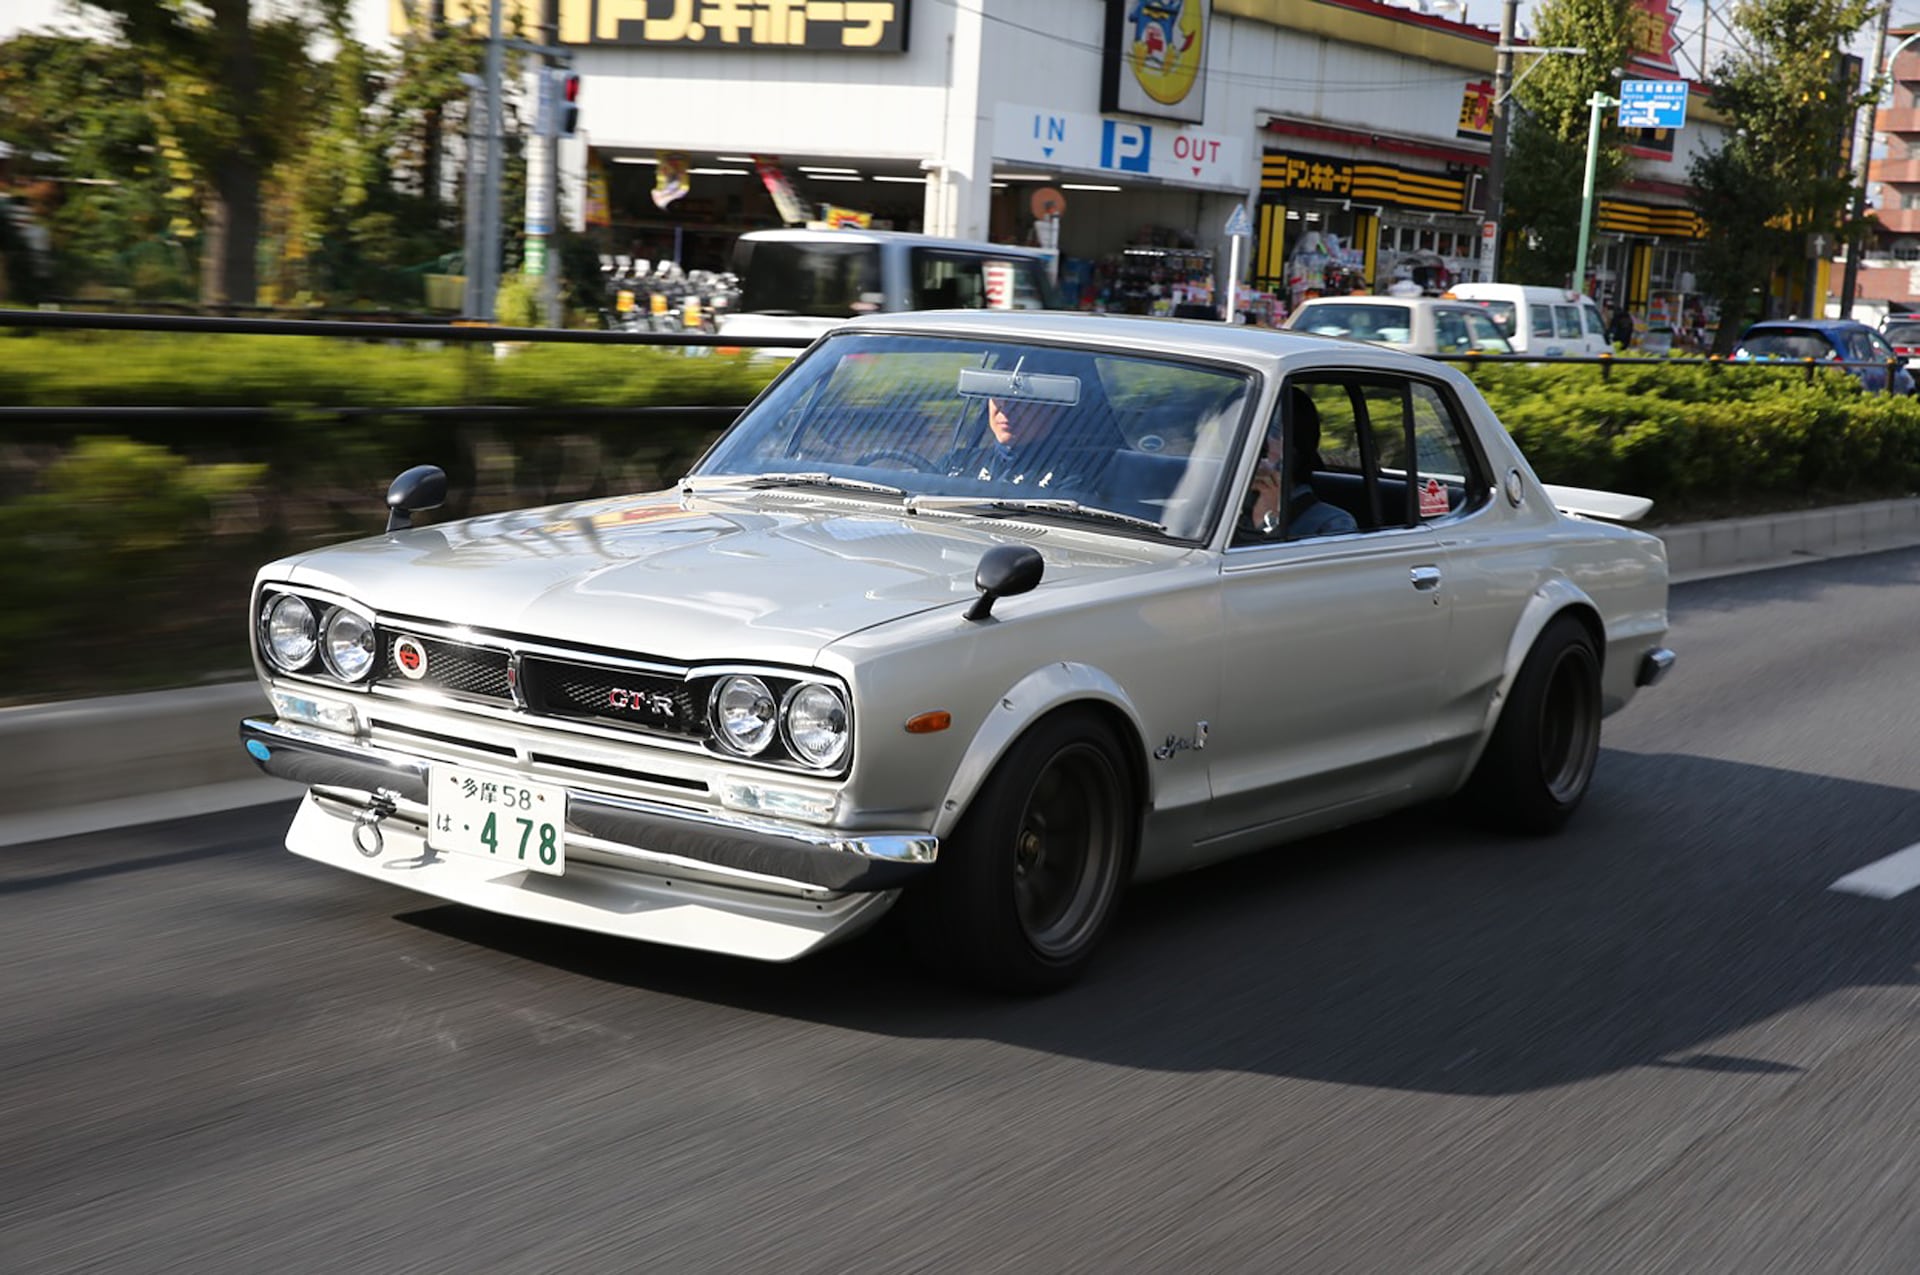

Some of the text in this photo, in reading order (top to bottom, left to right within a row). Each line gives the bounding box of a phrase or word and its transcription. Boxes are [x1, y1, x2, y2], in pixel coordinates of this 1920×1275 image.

[1033, 114, 1066, 142] IN
[1111, 122, 1145, 169] P
[1173, 135, 1221, 163] OUT
[609, 687, 675, 717] GT-R
